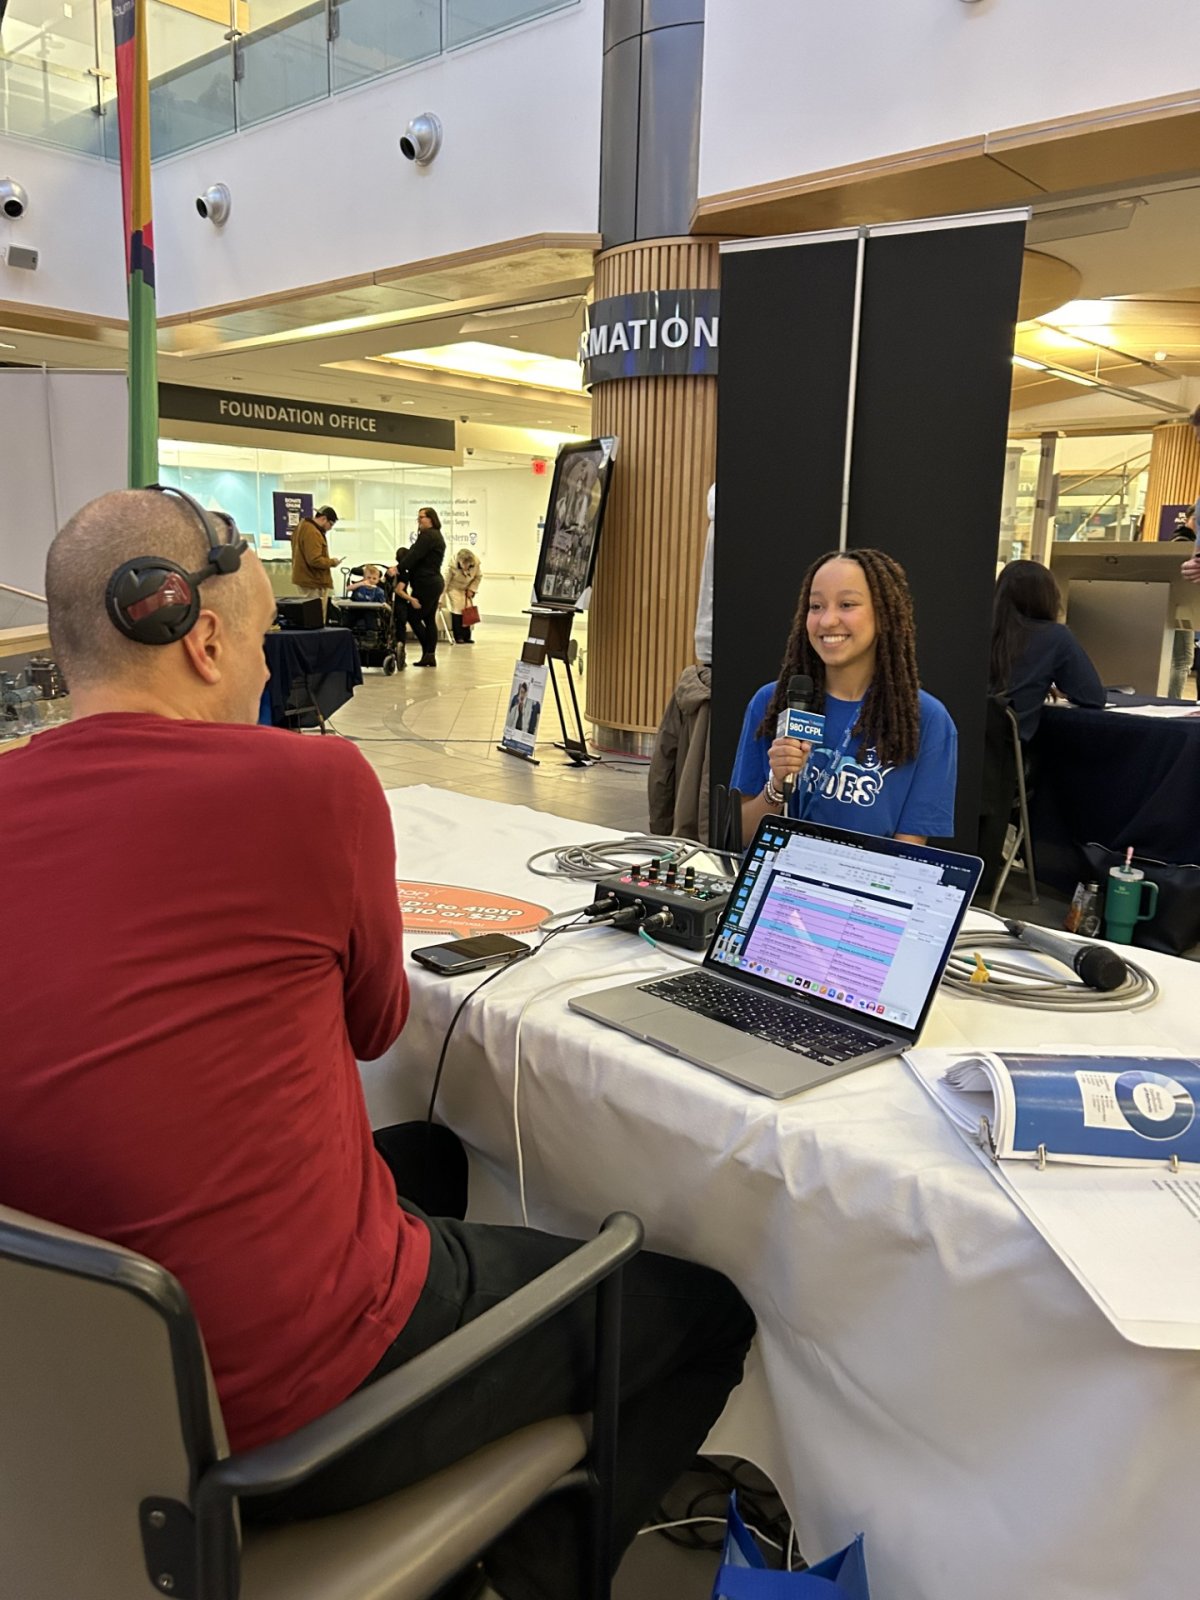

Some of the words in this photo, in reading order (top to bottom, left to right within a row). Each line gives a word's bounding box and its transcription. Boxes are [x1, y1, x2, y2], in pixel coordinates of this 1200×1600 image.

[219, 400, 324, 426] FOUNDATION
[329, 413, 377, 432] OFFICE
[789, 722, 804, 733] 980
[804, 725, 824, 737] CFPL
[462, 906, 524, 916] 41010
[468, 913, 511, 922] $25
